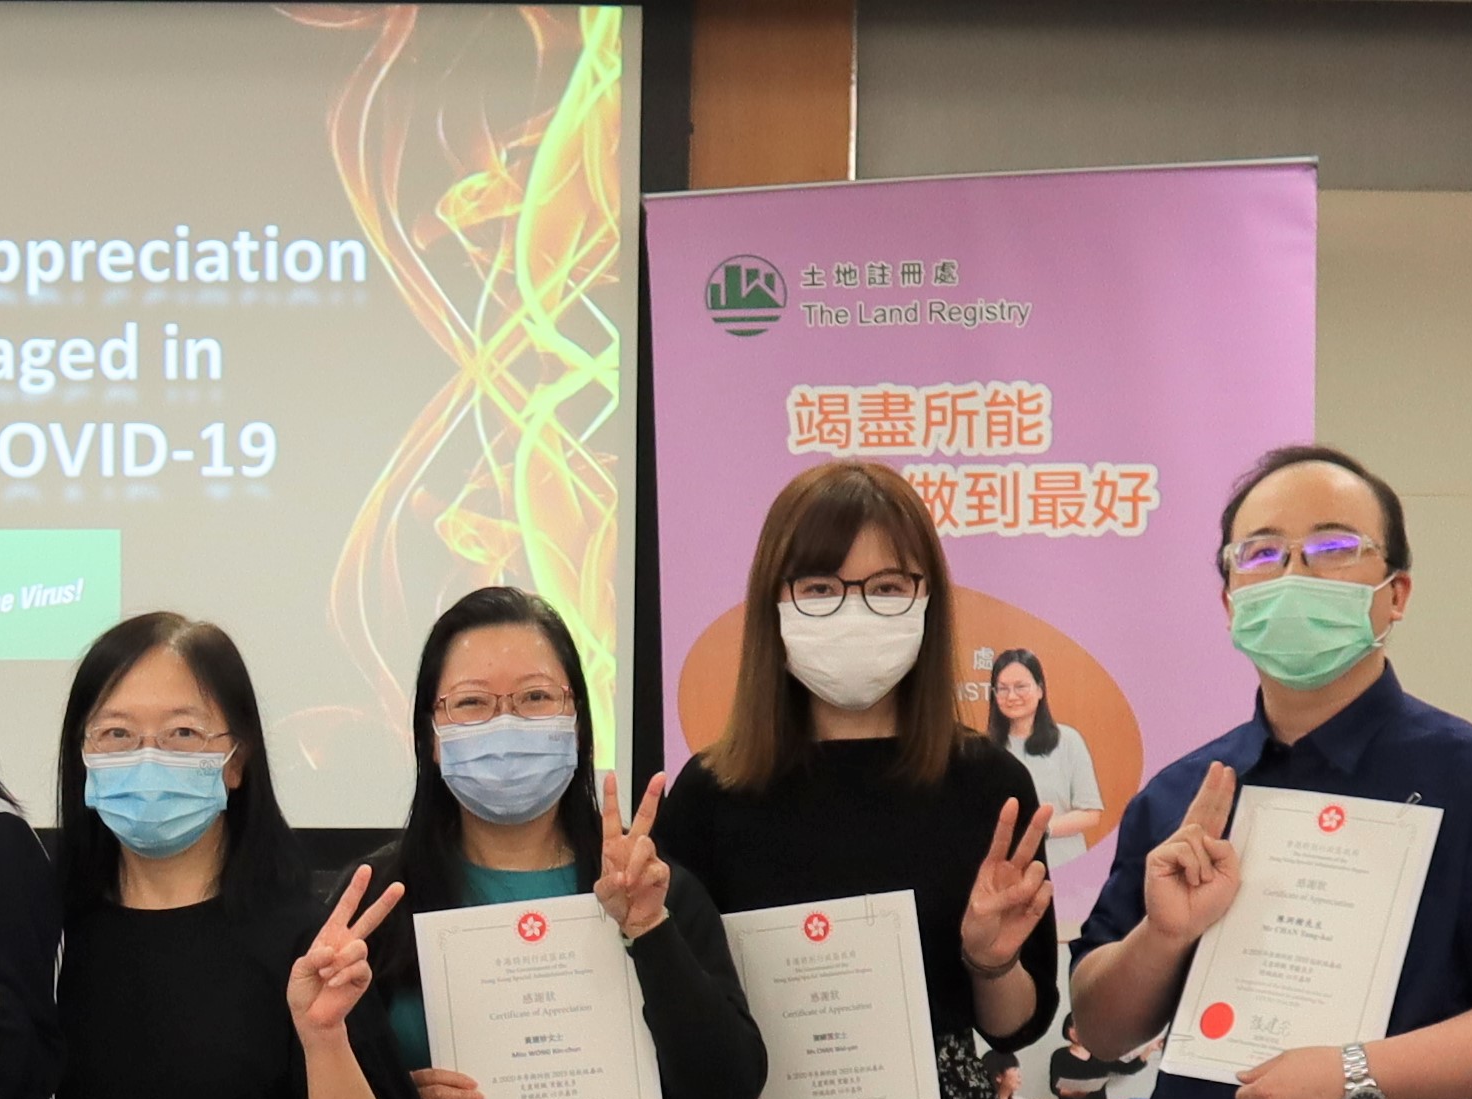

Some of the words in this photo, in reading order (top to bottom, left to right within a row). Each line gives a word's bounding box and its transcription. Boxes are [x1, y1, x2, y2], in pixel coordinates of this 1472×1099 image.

[802, 261, 958, 287] 土地註冊處
[802, 303, 850, 325] The
[858, 301, 919, 325] Land
[928, 299, 1030, 328] Registry
[163, 325, 224, 381] in
[794, 389, 1045, 449] 竭盡所能
[19, 578, 85, 611] Virus!
